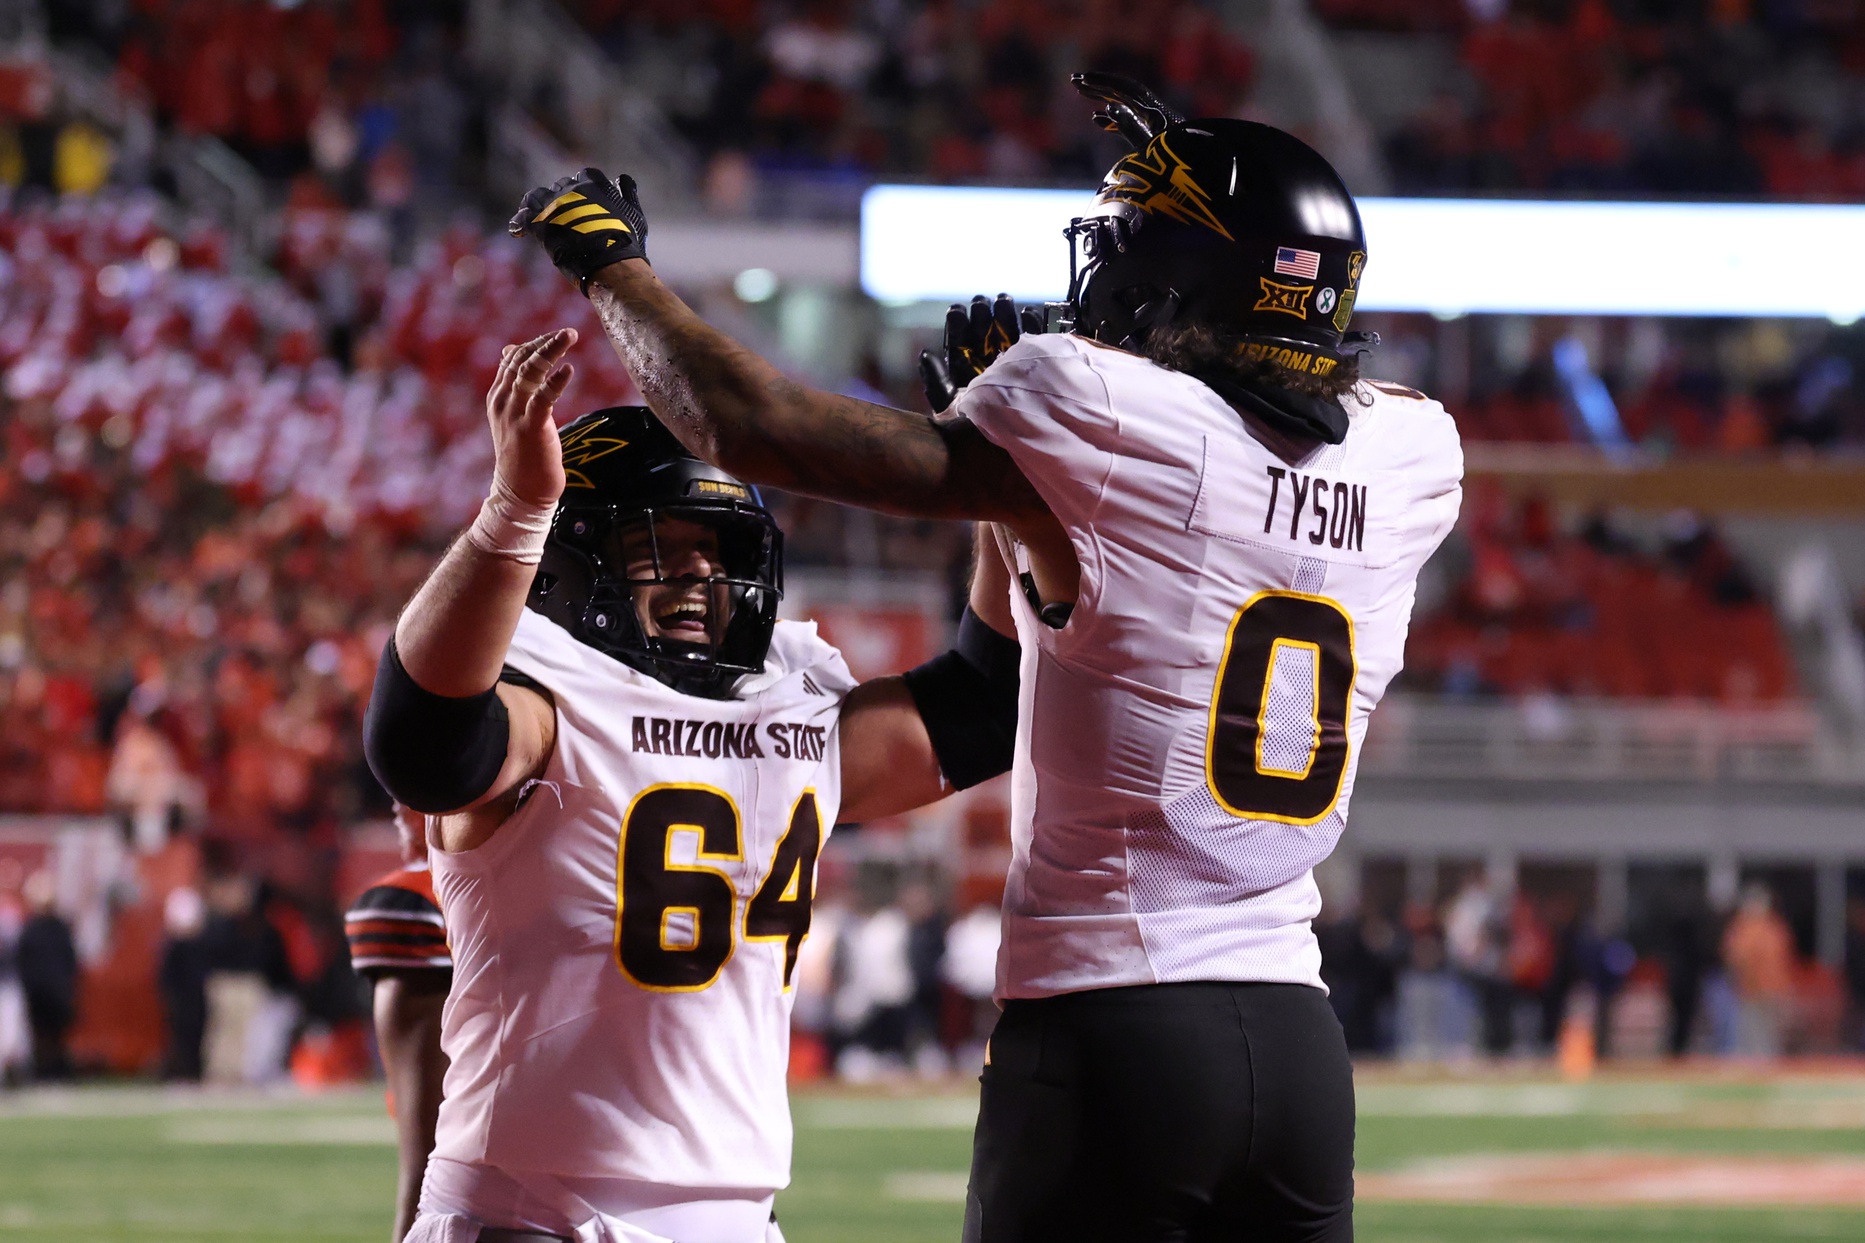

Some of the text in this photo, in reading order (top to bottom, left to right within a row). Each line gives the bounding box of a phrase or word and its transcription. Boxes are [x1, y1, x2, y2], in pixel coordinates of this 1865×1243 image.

[698, 481, 746, 498] SUN DEVILS
[1263, 465, 1367, 551] TYSON
[631, 716, 826, 762] ARIZONA STATE
[1205, 589, 1358, 826] 0
[614, 781, 824, 994] 64
